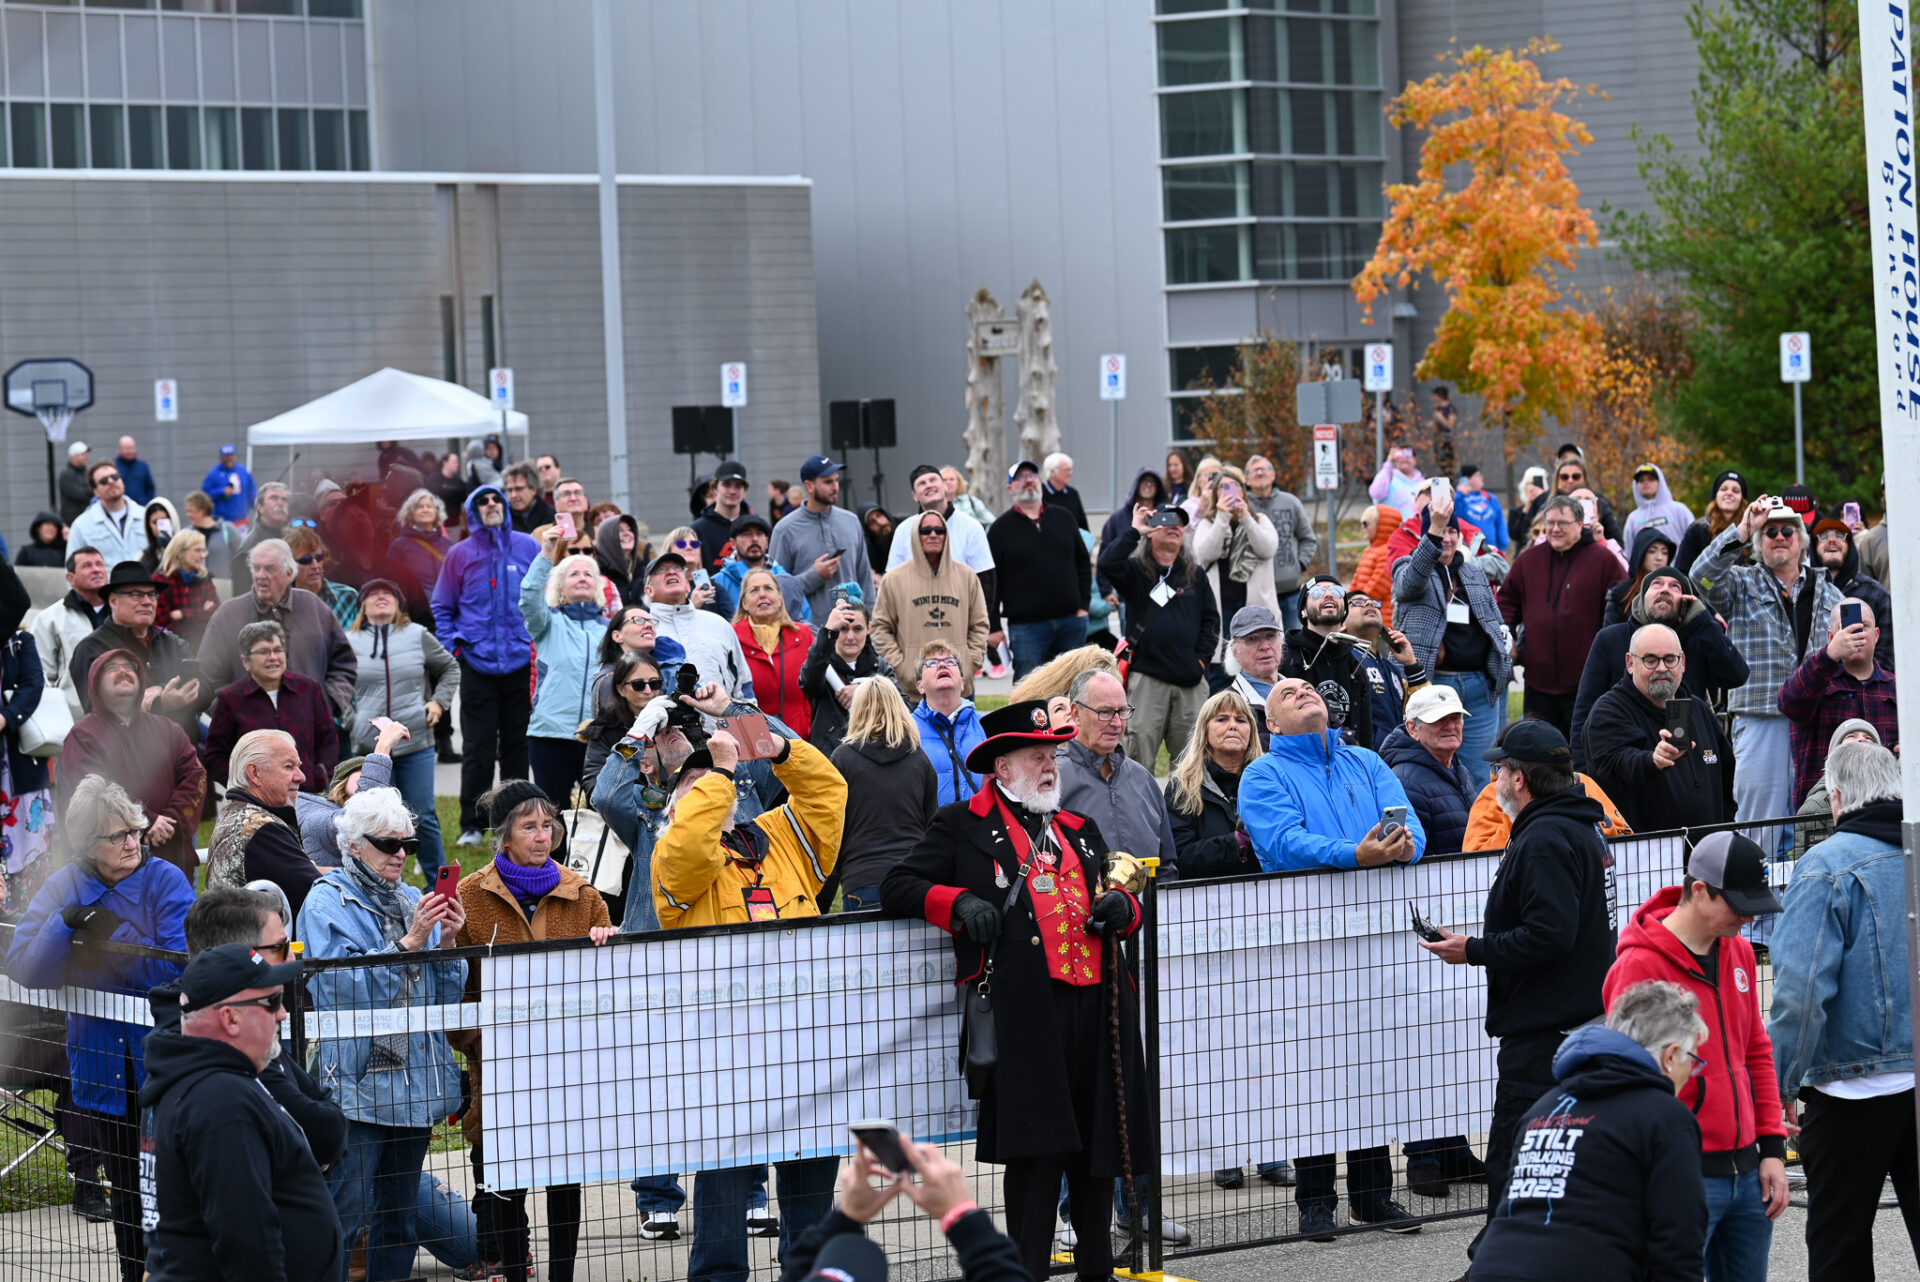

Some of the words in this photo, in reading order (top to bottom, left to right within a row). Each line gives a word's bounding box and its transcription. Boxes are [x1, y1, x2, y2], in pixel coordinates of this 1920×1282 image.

[1901, 228, 1920, 420] HOUSE
[1520, 1129, 1584, 1151] STILT
[1518, 1151, 1576, 1166] WALKING
[1513, 1164, 1572, 1178] ATTEMPT
[1507, 1178, 1567, 1199] 2023
